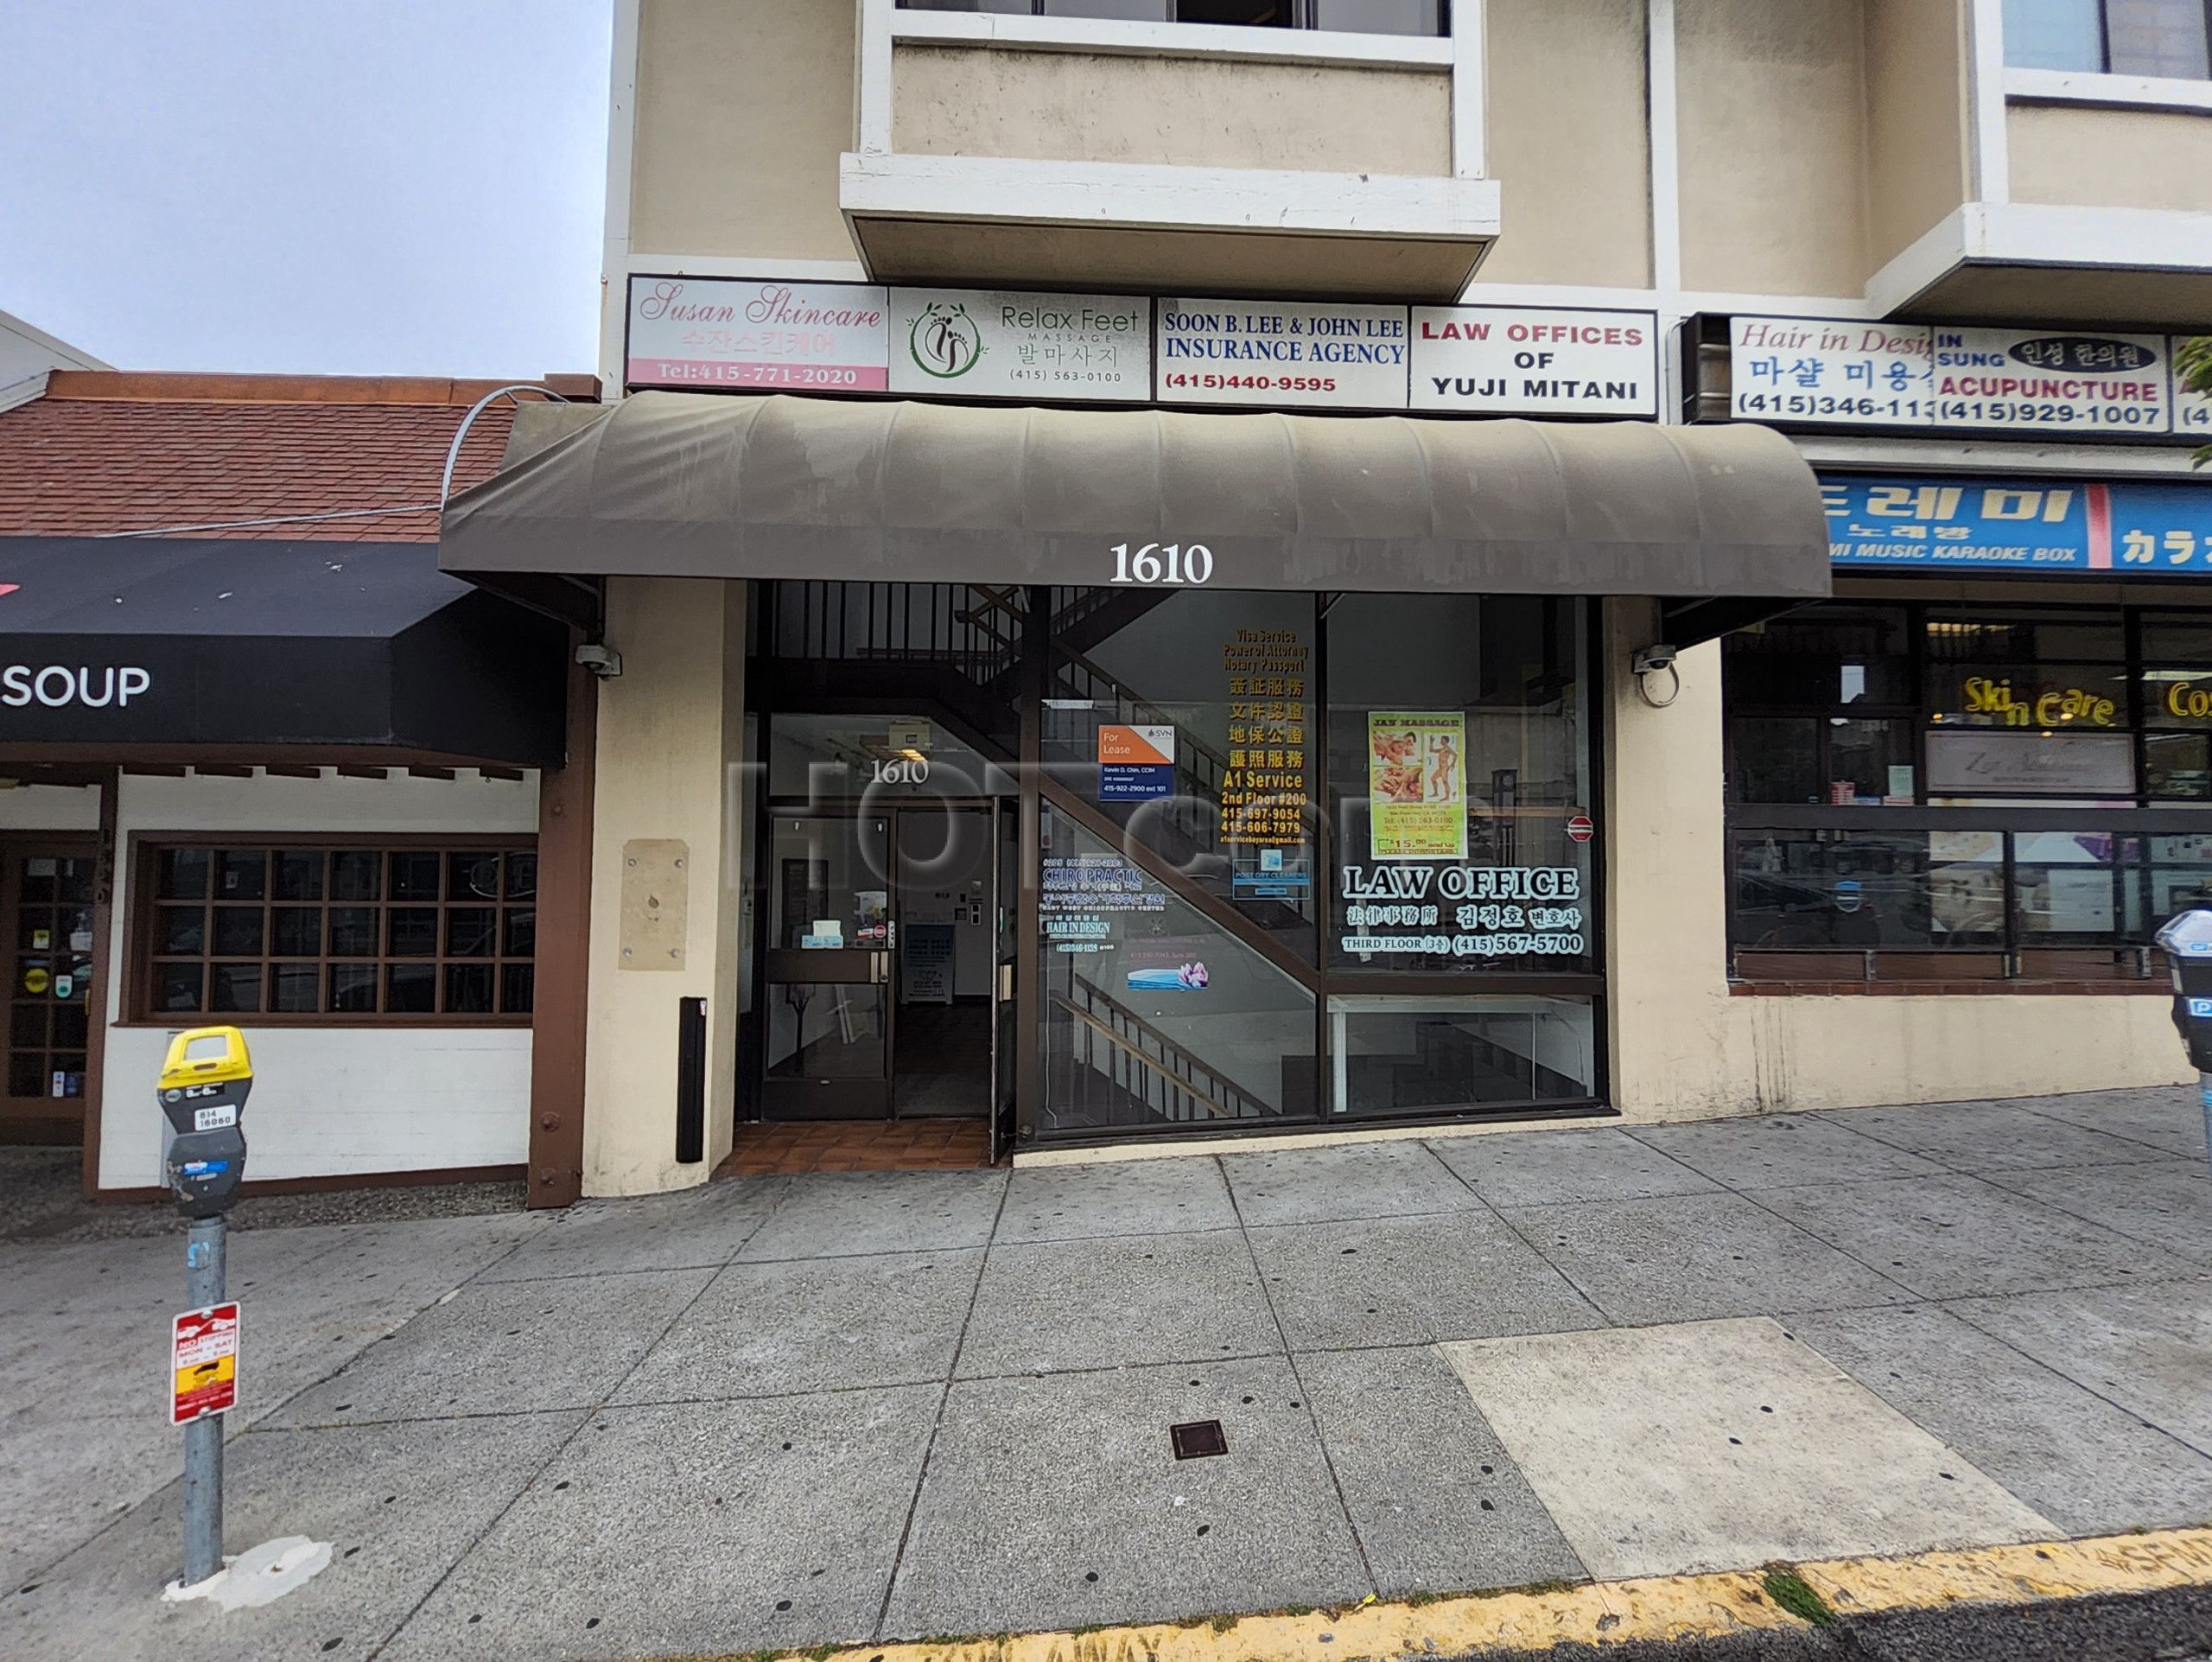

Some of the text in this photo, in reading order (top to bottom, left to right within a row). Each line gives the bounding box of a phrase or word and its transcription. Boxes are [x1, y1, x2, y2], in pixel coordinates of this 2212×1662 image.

[639, 282, 880, 327] Susan Skincare
[1001, 306, 1138, 332] Relax Feet
[1165, 312, 1404, 339] SOON B. LEE & JOHN LEE
[681, 328, 836, 357] 수잔스킨케어
[1027, 333, 1112, 343] MASSAGE
[1421, 322, 1643, 346] LAW OFFICES
[1738, 323, 1813, 349] Hair
[1819, 327, 1849, 351] in
[1937, 334, 1962, 347] IN
[1166, 338, 1406, 365] INSURANCE AGENCY
[1514, 352, 1554, 370] OF
[1937, 353, 2005, 367] SUNG
[658, 363, 856, 385] Tel:415-771-2020
[1010, 369, 1122, 382] (415) 563-0100
[1165, 373, 1337, 392] (415)440-9595
[1431, 377, 1638, 400] YUJI MITANI
[1939, 377, 2158, 401] ACUPUNCTURE
[1941, 401, 2160, 424] (415)929-1007
[1855, 544, 1928, 558] MUSIC
[1932, 545, 2028, 560] KARAOKE
[2032, 547, 2077, 562] BOX
[2122, 529, 2212, 564] カラ
[1110, 543, 1213, 584] 1610
[1, 665, 151, 707] SOUP
[1103, 732, 1119, 742] For
[1103, 745, 1131, 755] Lease
[869, 758, 929, 785] 1610
[1224, 771, 1303, 788] A1 Service
[1221, 791, 1306, 806] 2nd Floor #200
[1221, 808, 1301, 820] 415-697-9054
[1221, 821, 1301, 833] 415-606-7979
[1043, 868, 1142, 882] CHIROPRACTIC
[1343, 866, 1580, 900] LAW OFFICE
[1046, 921, 1110, 933] HAIR IN DESIGN
[1456, 905, 1581, 930] 김정호 변호사
[1343, 937, 1382, 952] THIRD
[1383, 937, 1422, 952] FLOOR
[1452, 933, 1584, 956] (415)567-5700
